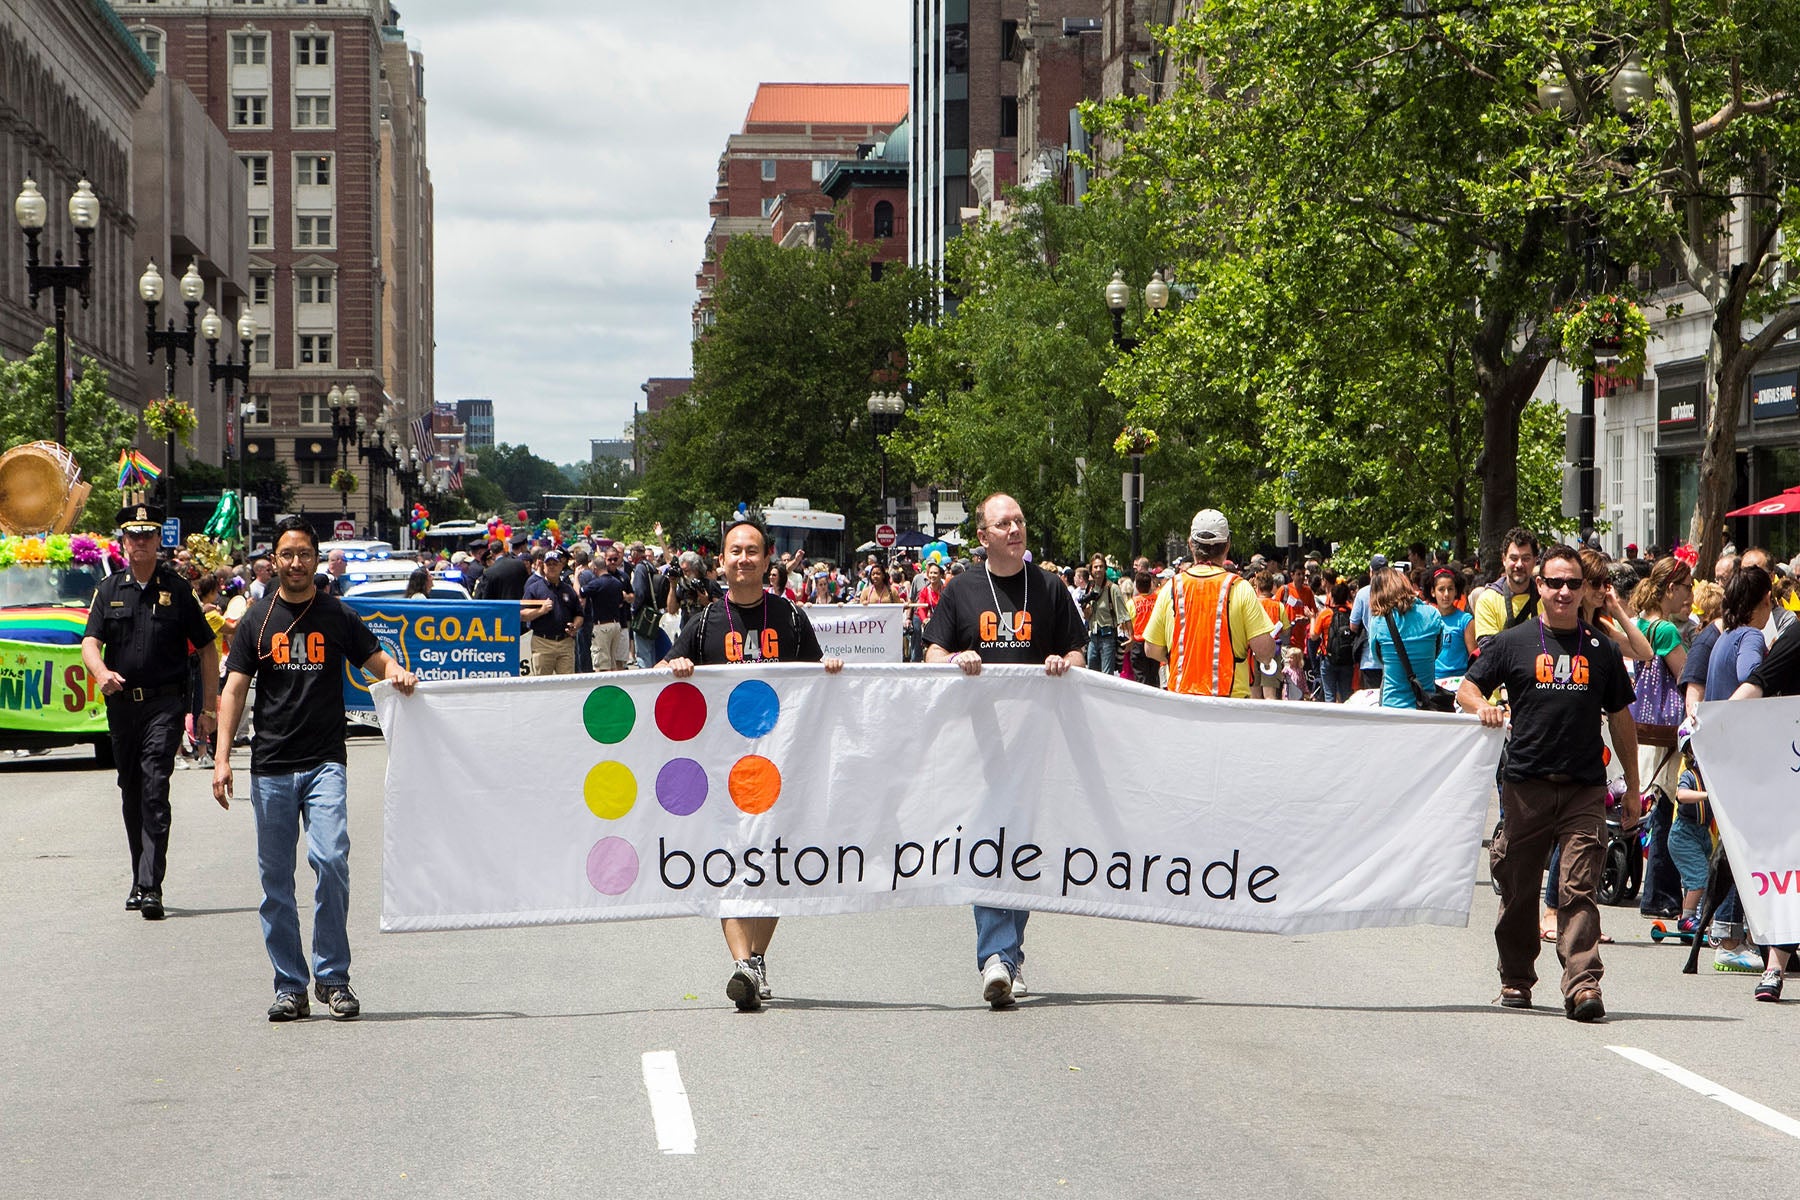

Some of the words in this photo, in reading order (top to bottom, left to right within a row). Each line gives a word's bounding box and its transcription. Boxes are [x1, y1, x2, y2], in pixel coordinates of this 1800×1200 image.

[414, 616, 516, 642] G.O.A.L.
[835, 620, 888, 634] HAPPY
[980, 610, 1032, 641] G4G
[271, 632, 325, 664] G4G
[724, 628, 779, 661] G4G
[824, 645, 852, 656] Angela
[854, 644, 885, 654] Menino
[980, 641, 994, 649] GAY
[420, 648, 448, 665] Gay
[450, 648, 506, 663] Officers
[415, 667, 458, 680] Action
[461, 667, 511, 679] League
[1535, 653, 1590, 684] G4G
[1566, 683, 1588, 691] GOOD
[659, 836, 864, 890] boston
[891, 824, 1043, 891] pride
[1061, 849, 1280, 904] parade
